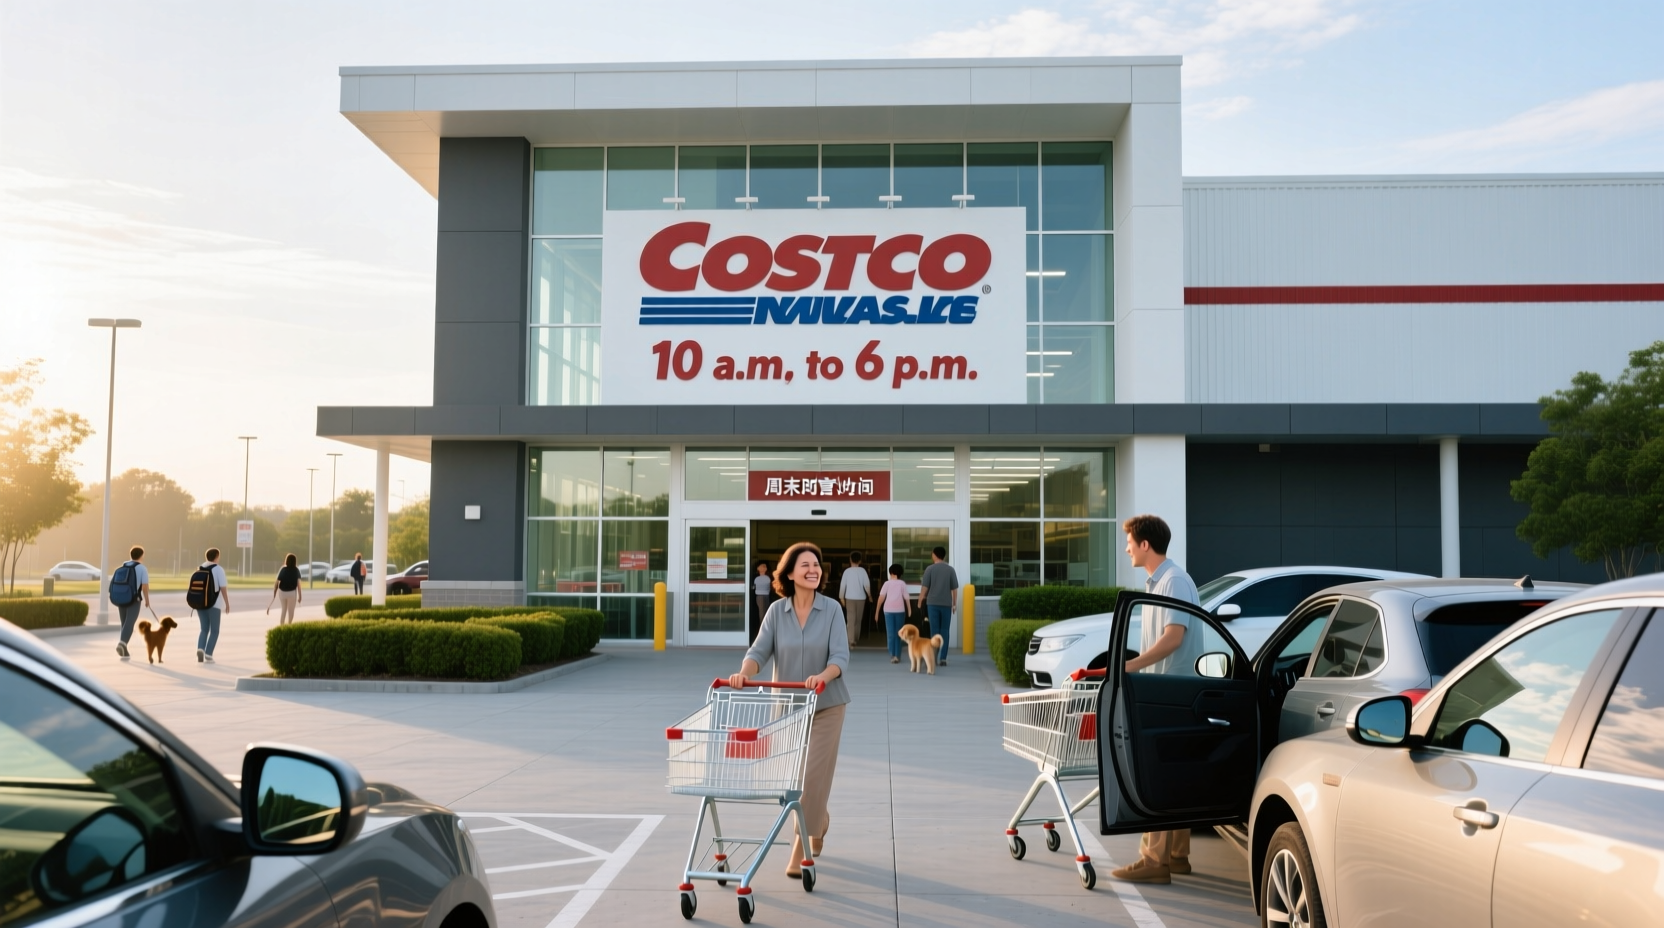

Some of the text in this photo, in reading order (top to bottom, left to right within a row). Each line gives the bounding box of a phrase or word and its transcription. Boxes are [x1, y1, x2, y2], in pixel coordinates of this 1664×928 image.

[639, 221, 992, 292] COSTCO
[652, 339, 703, 381] 10
[806, 350, 844, 380] to
[855, 339, 885, 381] 6
[892, 355, 978, 389] p.m.
